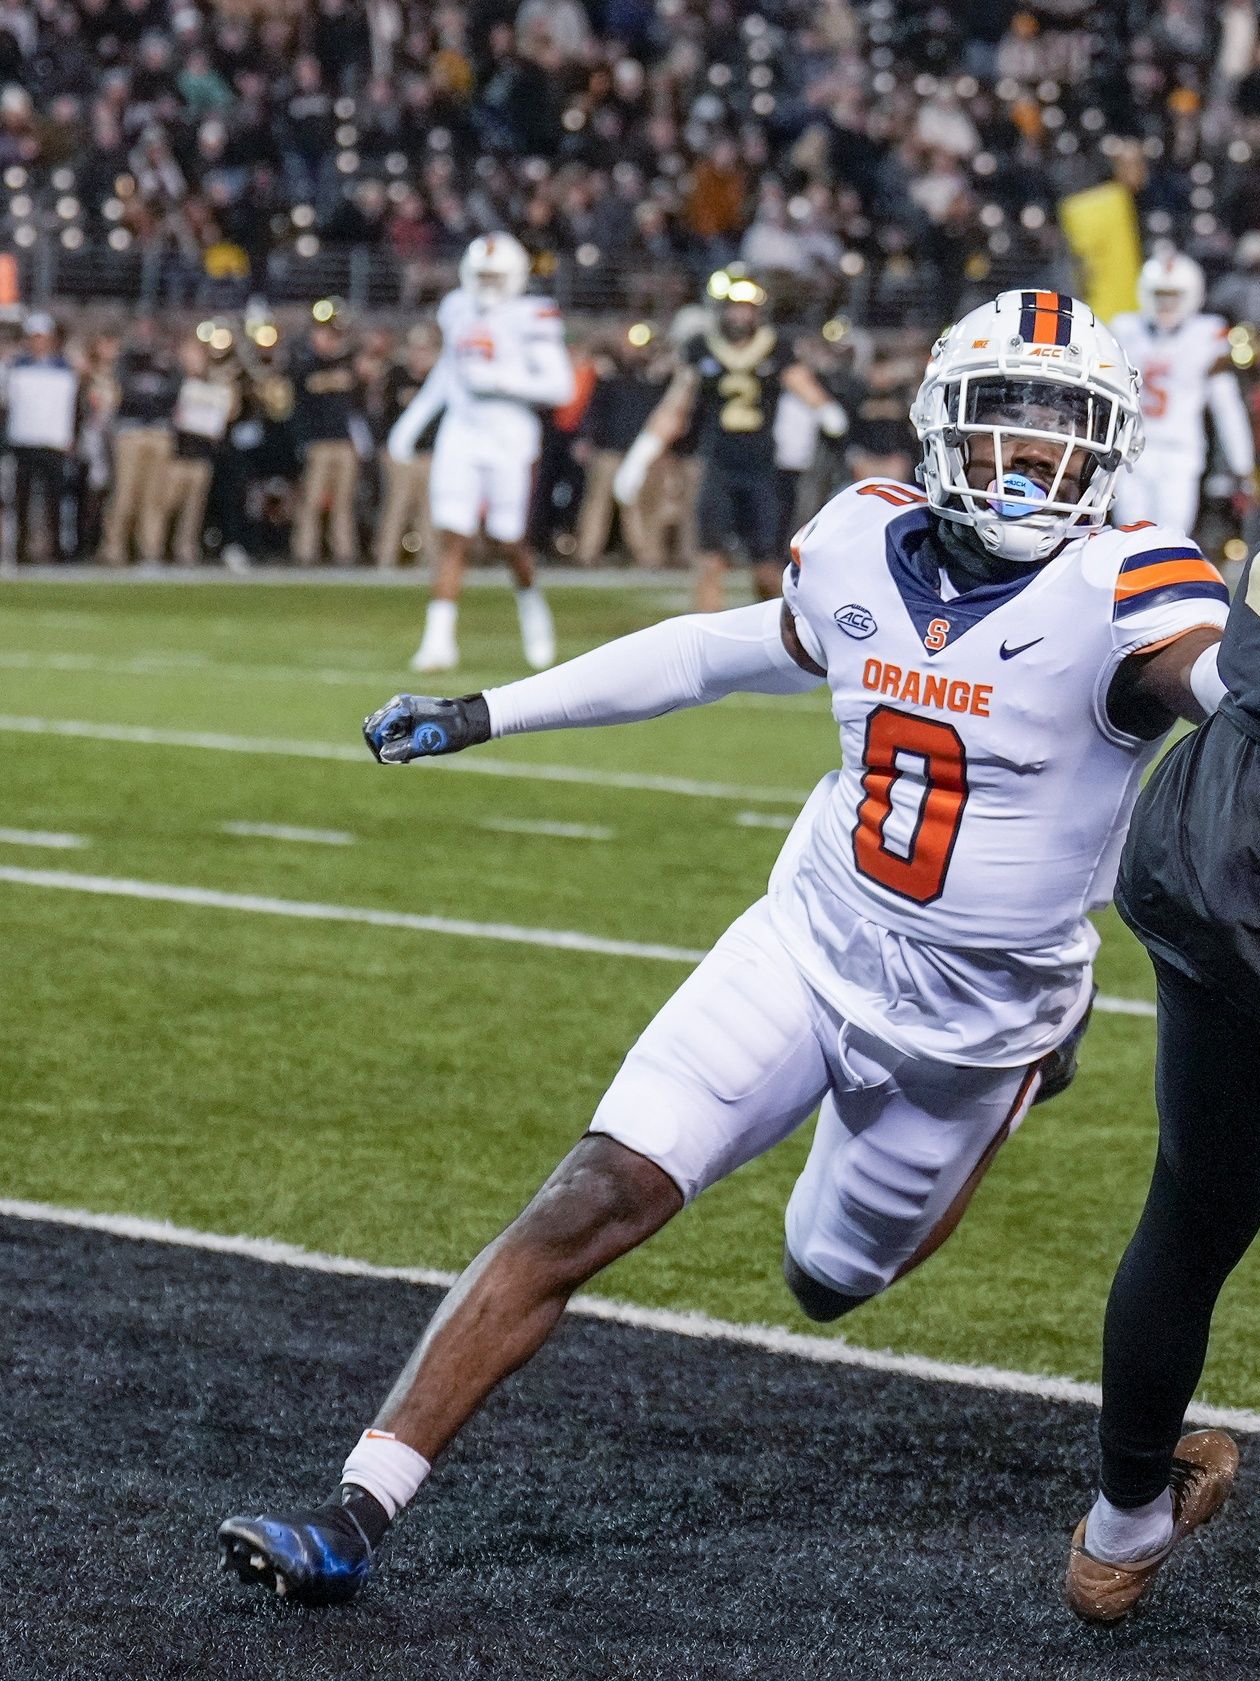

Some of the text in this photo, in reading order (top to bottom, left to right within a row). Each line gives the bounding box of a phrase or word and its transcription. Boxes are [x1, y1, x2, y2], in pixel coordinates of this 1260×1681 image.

[1027, 347, 1063, 358] ACC
[719, 372, 765, 433] 2
[840, 611, 873, 630] ACC
[924, 617, 951, 651] S
[861, 657, 994, 718] ORANGE
[851, 703, 970, 908] 0
